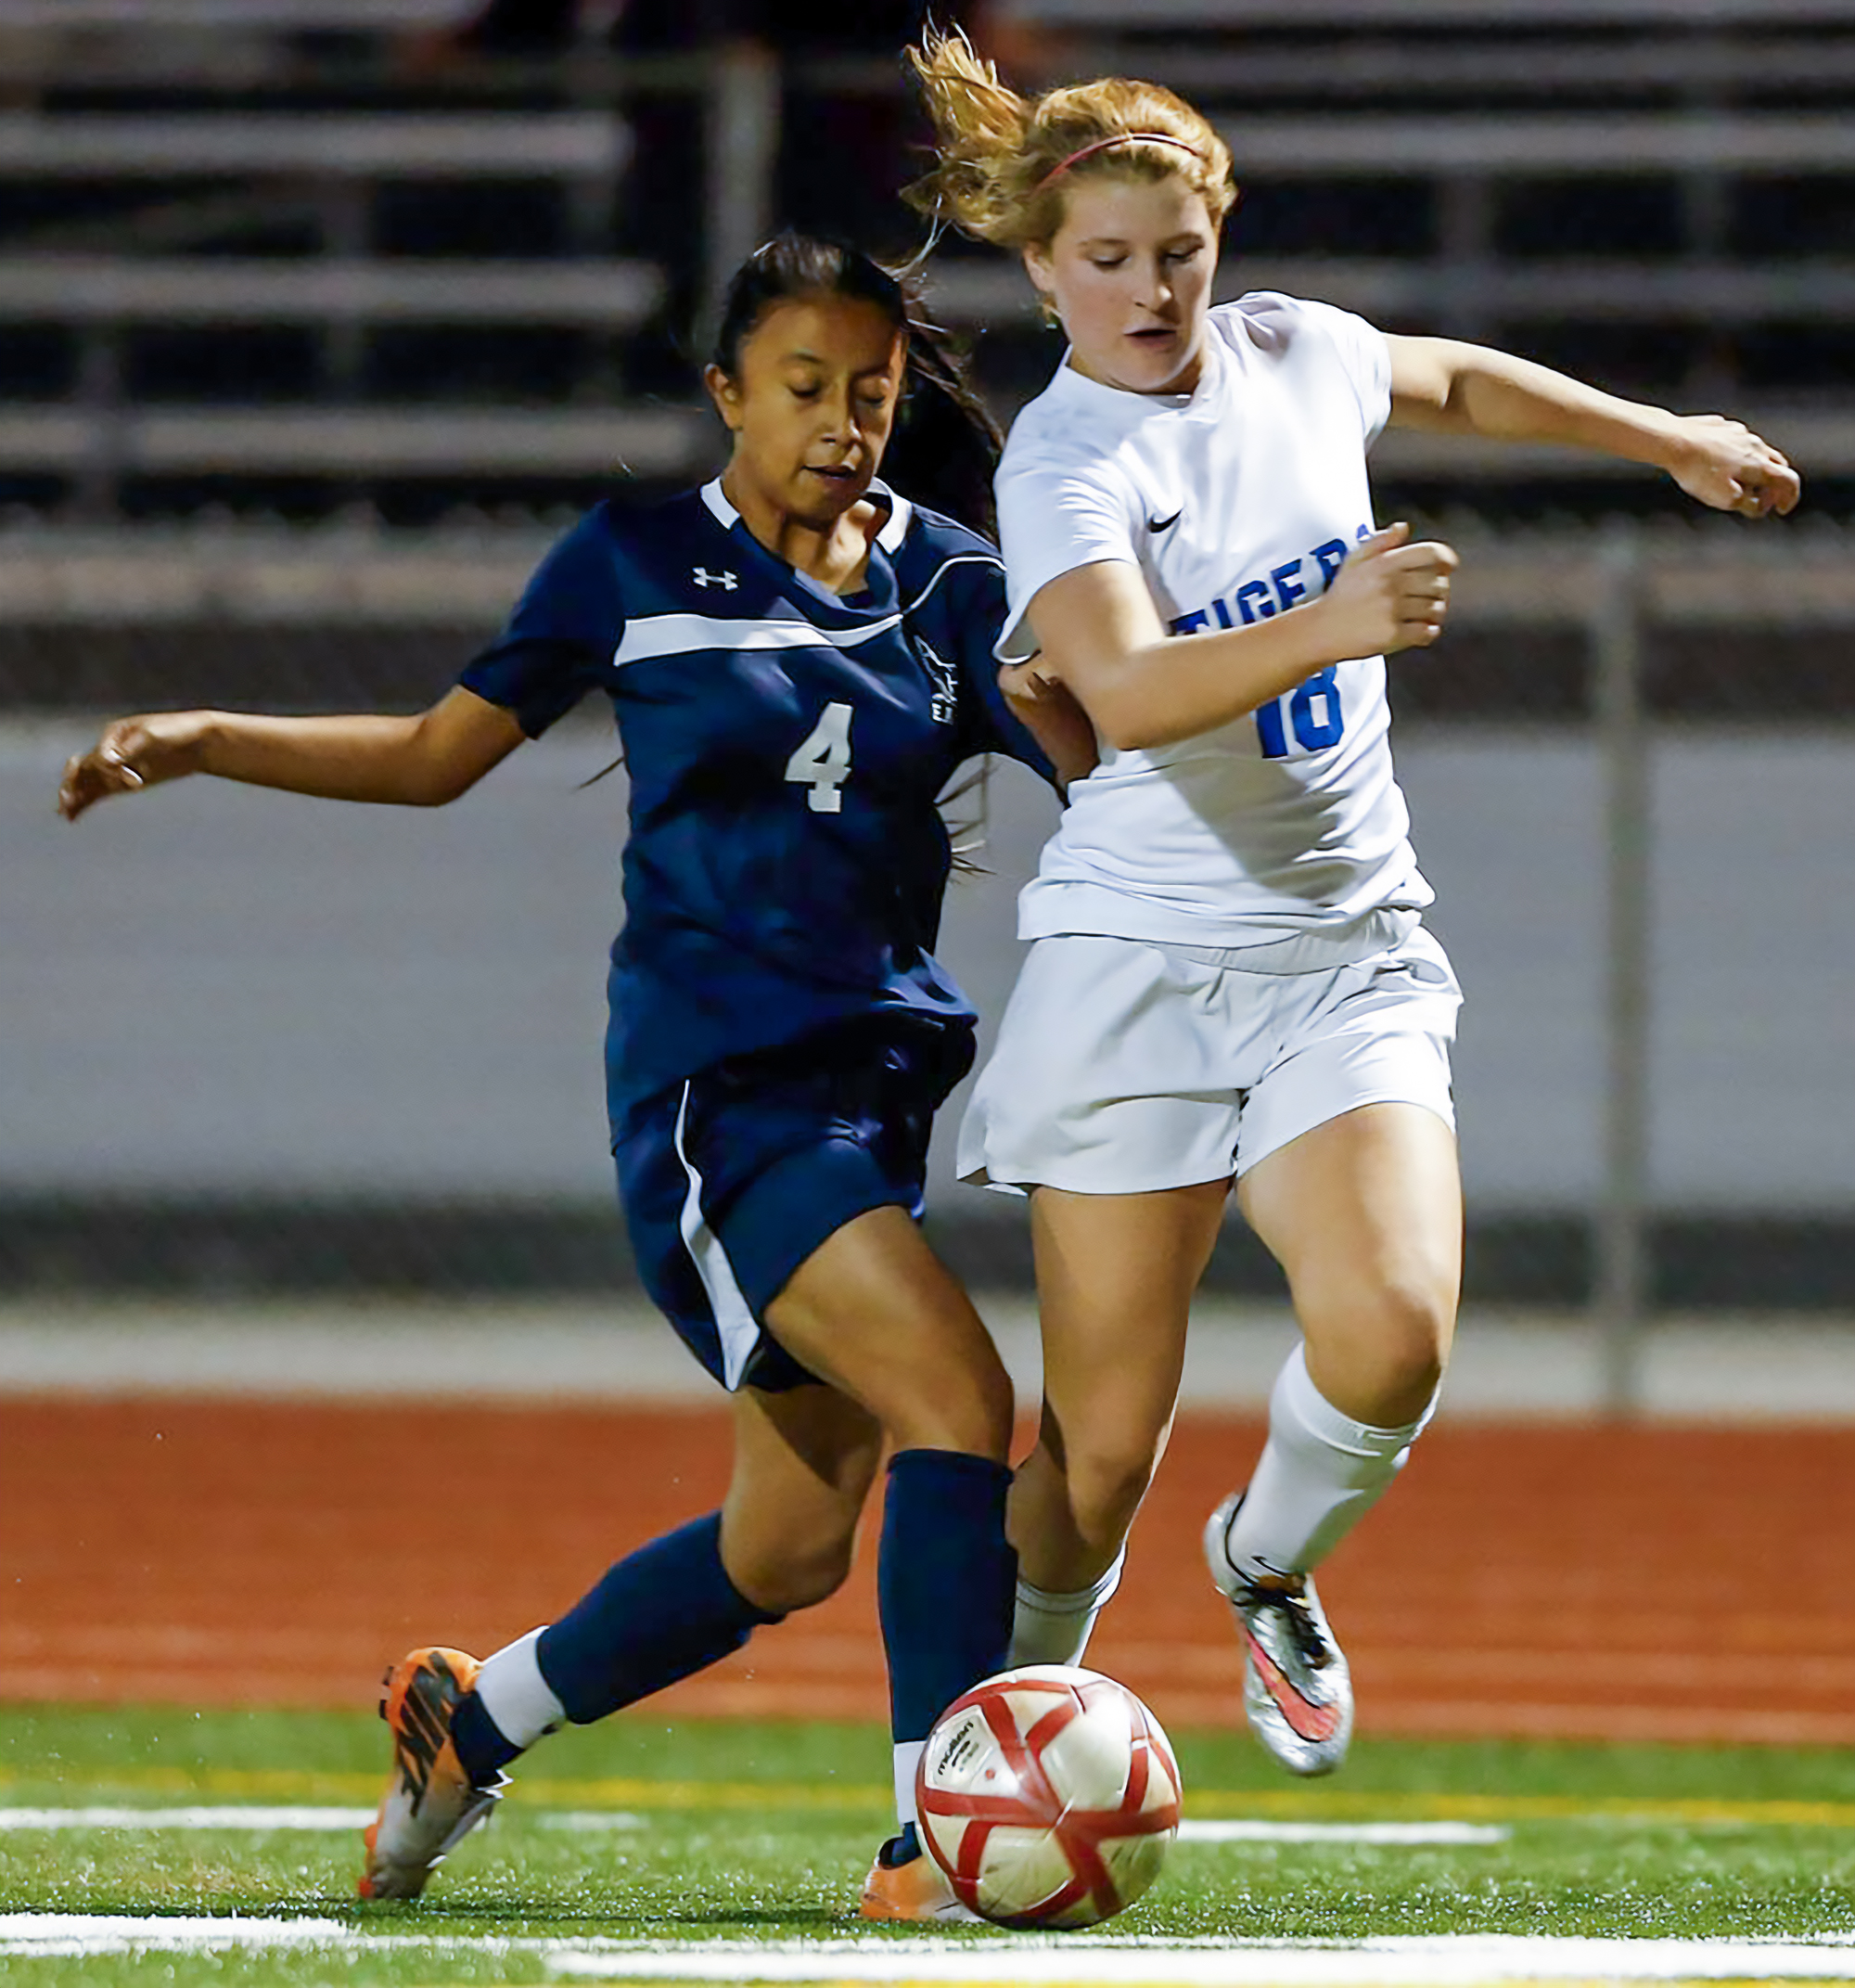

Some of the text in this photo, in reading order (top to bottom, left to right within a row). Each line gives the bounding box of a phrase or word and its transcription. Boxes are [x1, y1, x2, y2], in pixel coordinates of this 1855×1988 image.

[1168, 523, 1371, 637] TIGER
[785, 701, 853, 813] 4
[1256, 665, 1345, 759] 18
